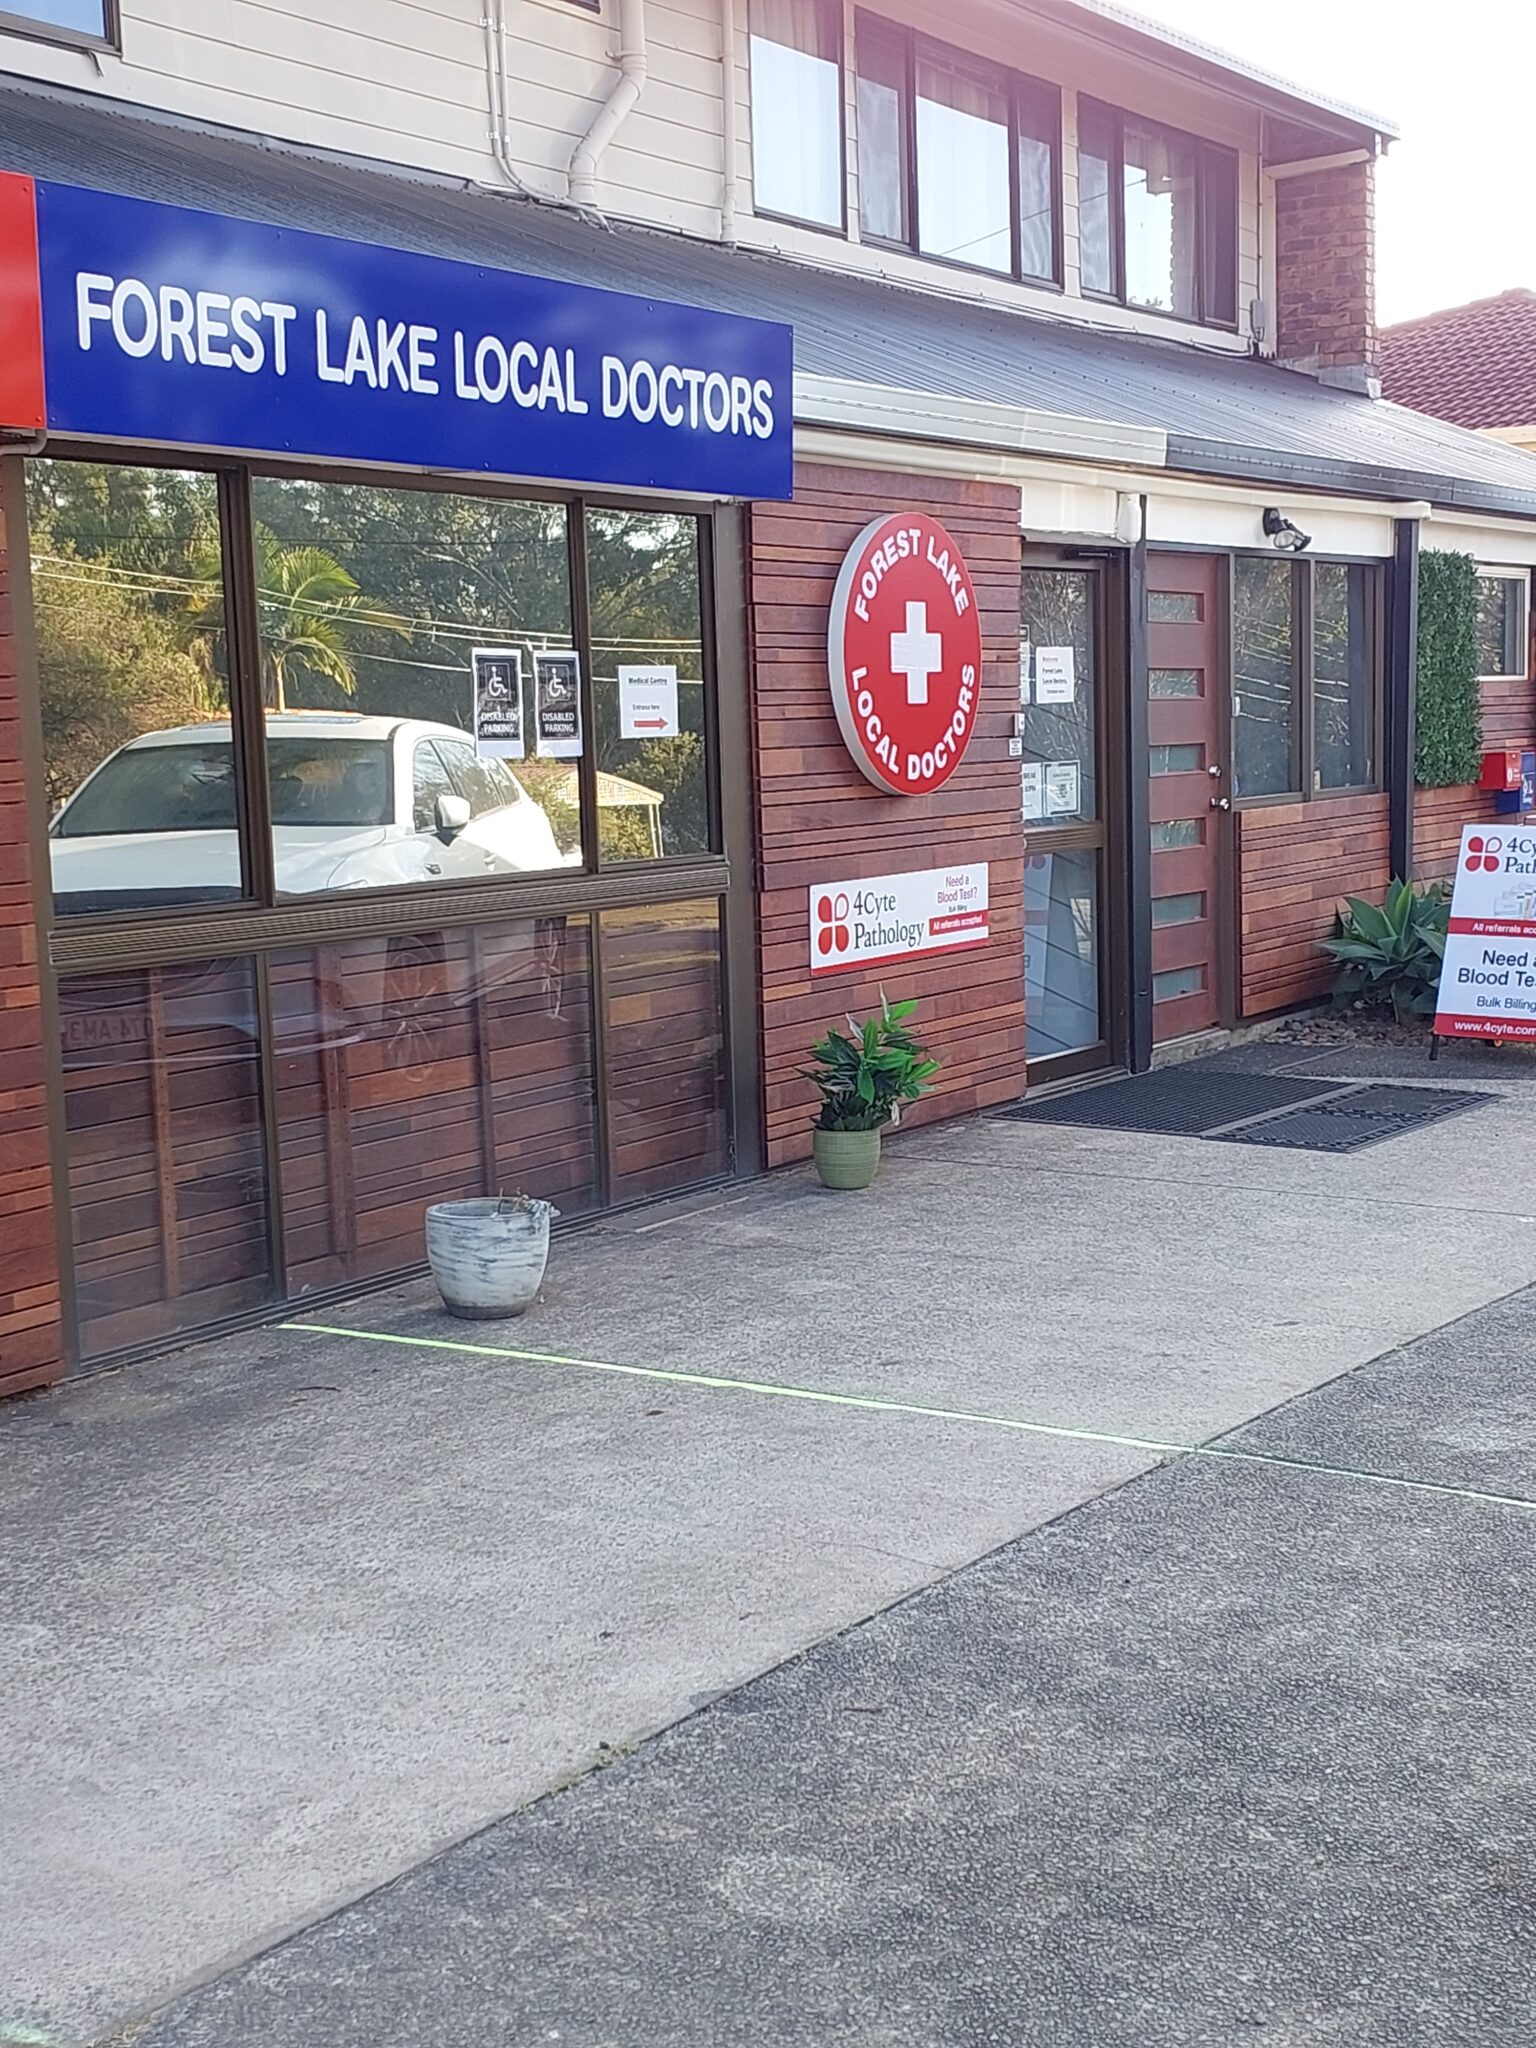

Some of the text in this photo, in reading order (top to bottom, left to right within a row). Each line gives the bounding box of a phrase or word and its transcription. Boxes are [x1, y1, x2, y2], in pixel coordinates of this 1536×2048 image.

[77, 272, 774, 439] FOREST LAKE LOCAL DOCTORS
[853, 528, 969, 622] FOREST LAKE
[628, 676, 668, 685] Medical Centre
[481, 712, 517, 721] DISABLED
[542, 712, 575, 721] DISABLED
[852, 664, 975, 780] LOCAL DOCTORS
[483, 724, 514, 733] PARKING
[544, 723, 574, 733] PARKING
[946, 874, 969, 888] Need a
[937, 886, 978, 904] Blood Test?
[853, 889, 896, 920] 4Cyte
[853, 919, 924, 950] Pathology
[1472, 922, 1484, 931] All
[1485, 922, 1521, 933] referrals
[1482, 950, 1529, 967] Need
[1458, 967, 1536, 987] Blood Te
[1476, 995, 1536, 1013] Bulk Billing
